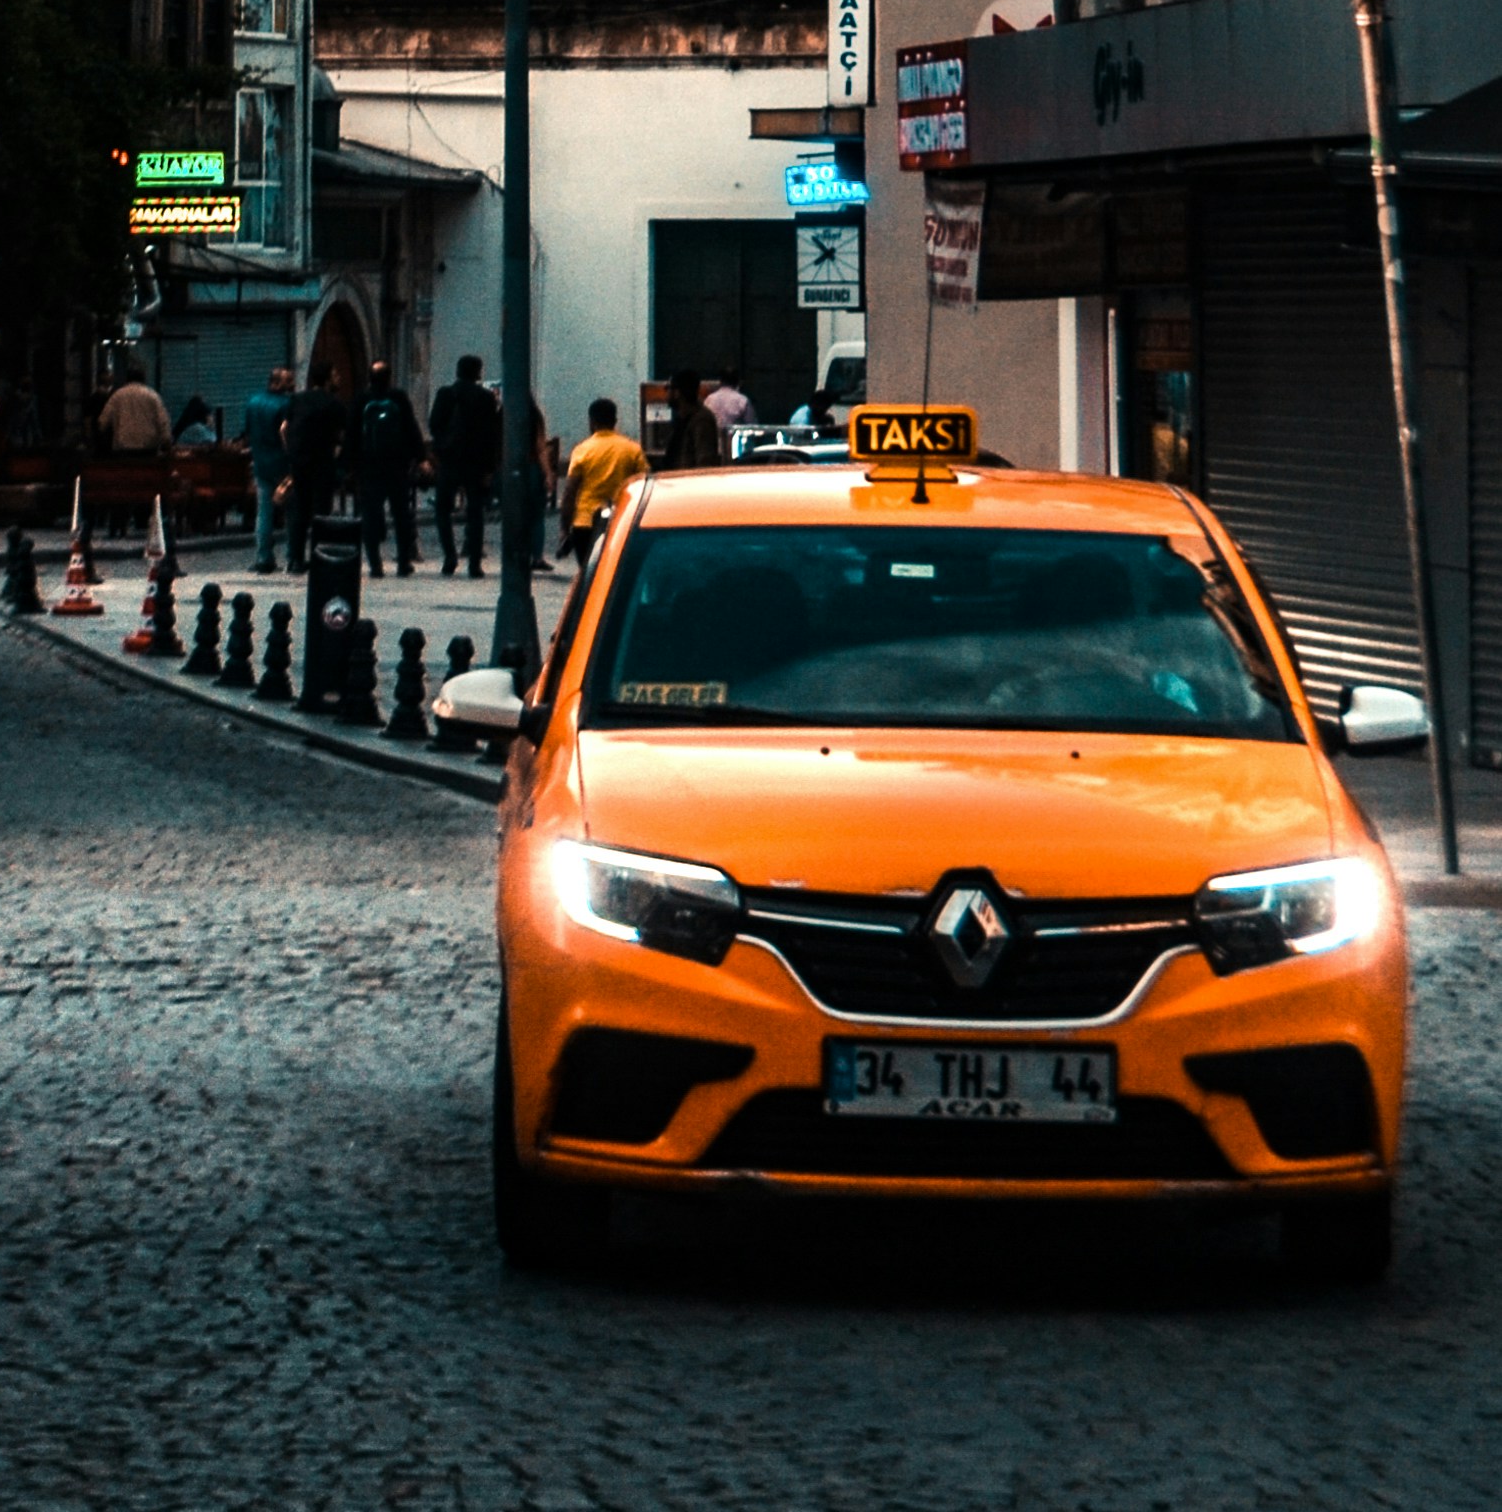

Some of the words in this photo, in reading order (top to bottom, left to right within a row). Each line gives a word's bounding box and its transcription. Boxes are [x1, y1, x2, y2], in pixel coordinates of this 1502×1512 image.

[857, 1051, 903, 1097] 34
[934, 1052, 1008, 1100] THJ
[1052, 1056, 1102, 1102] 44
